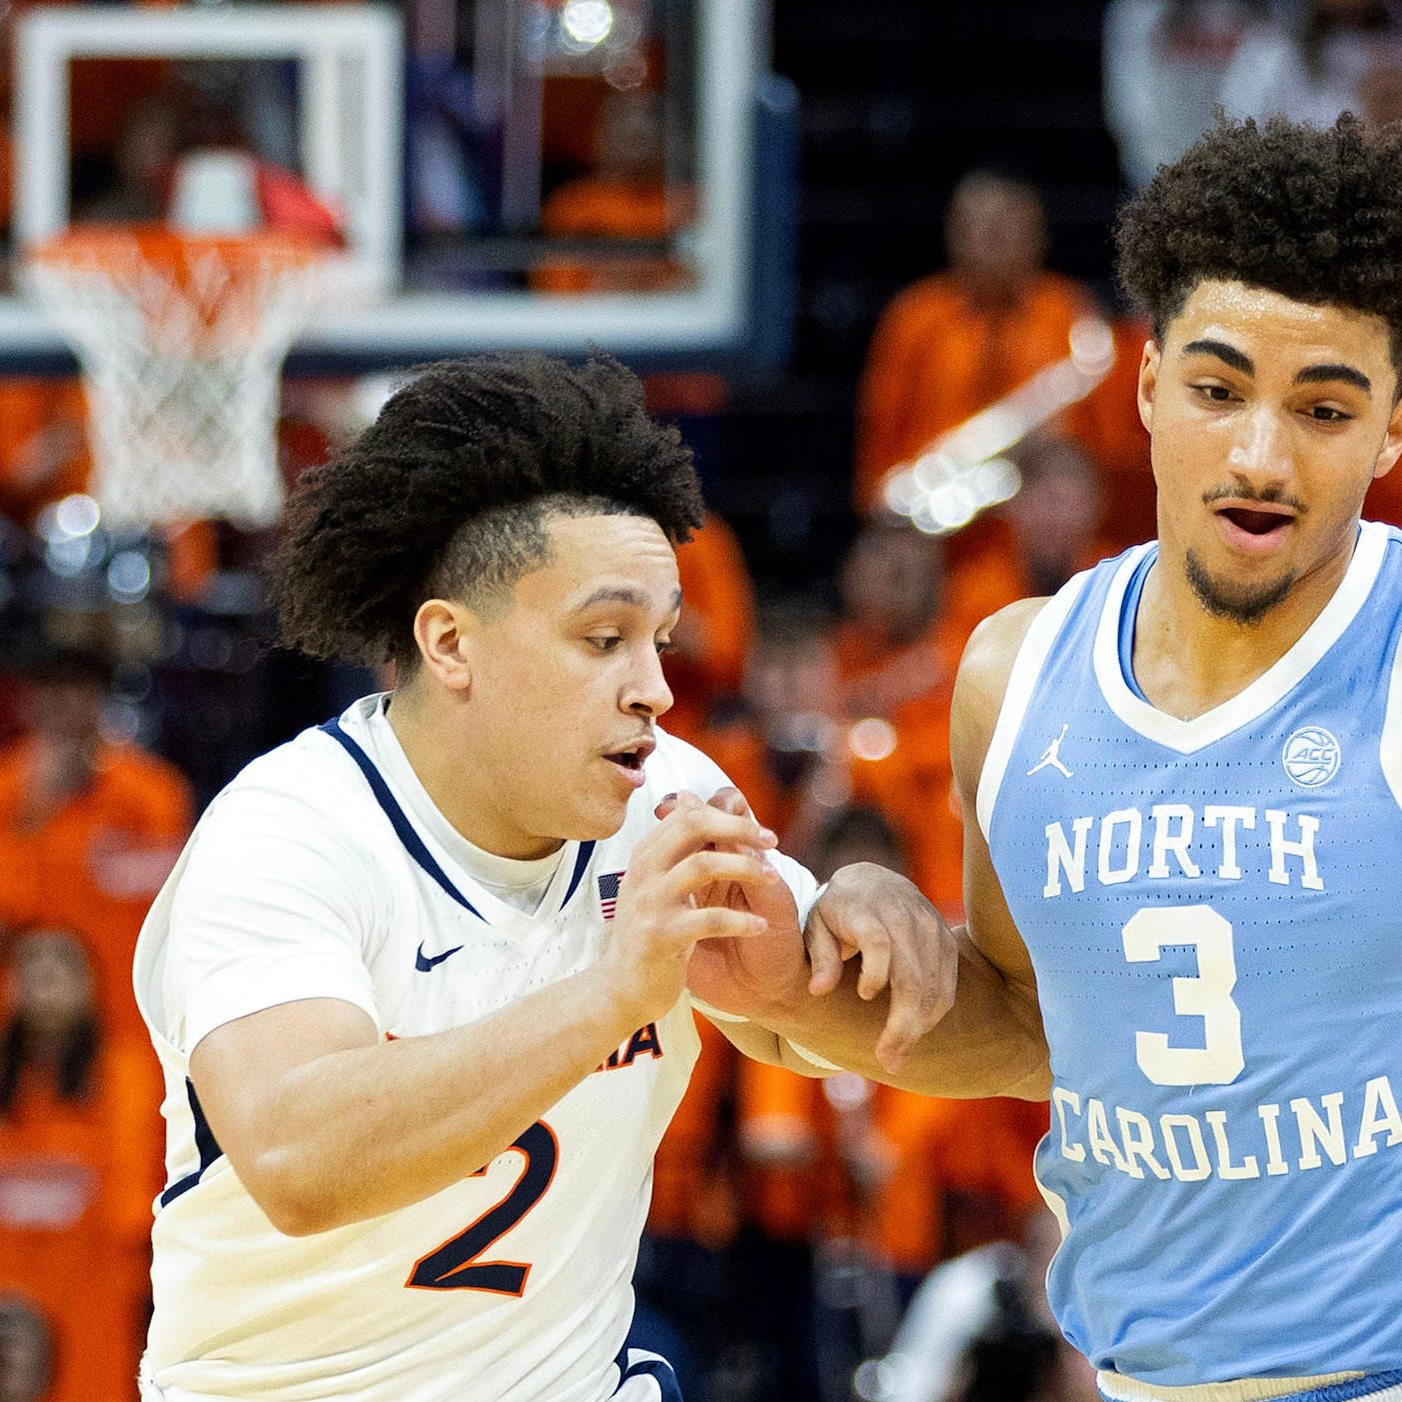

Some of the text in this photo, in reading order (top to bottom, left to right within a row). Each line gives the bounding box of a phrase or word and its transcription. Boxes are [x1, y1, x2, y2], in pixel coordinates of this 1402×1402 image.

[1291, 747, 1336, 761] ACC
[1044, 803, 1324, 897] NORTH
[1121, 904, 1245, 1086] 3
[404, 1118, 560, 1298] 2
